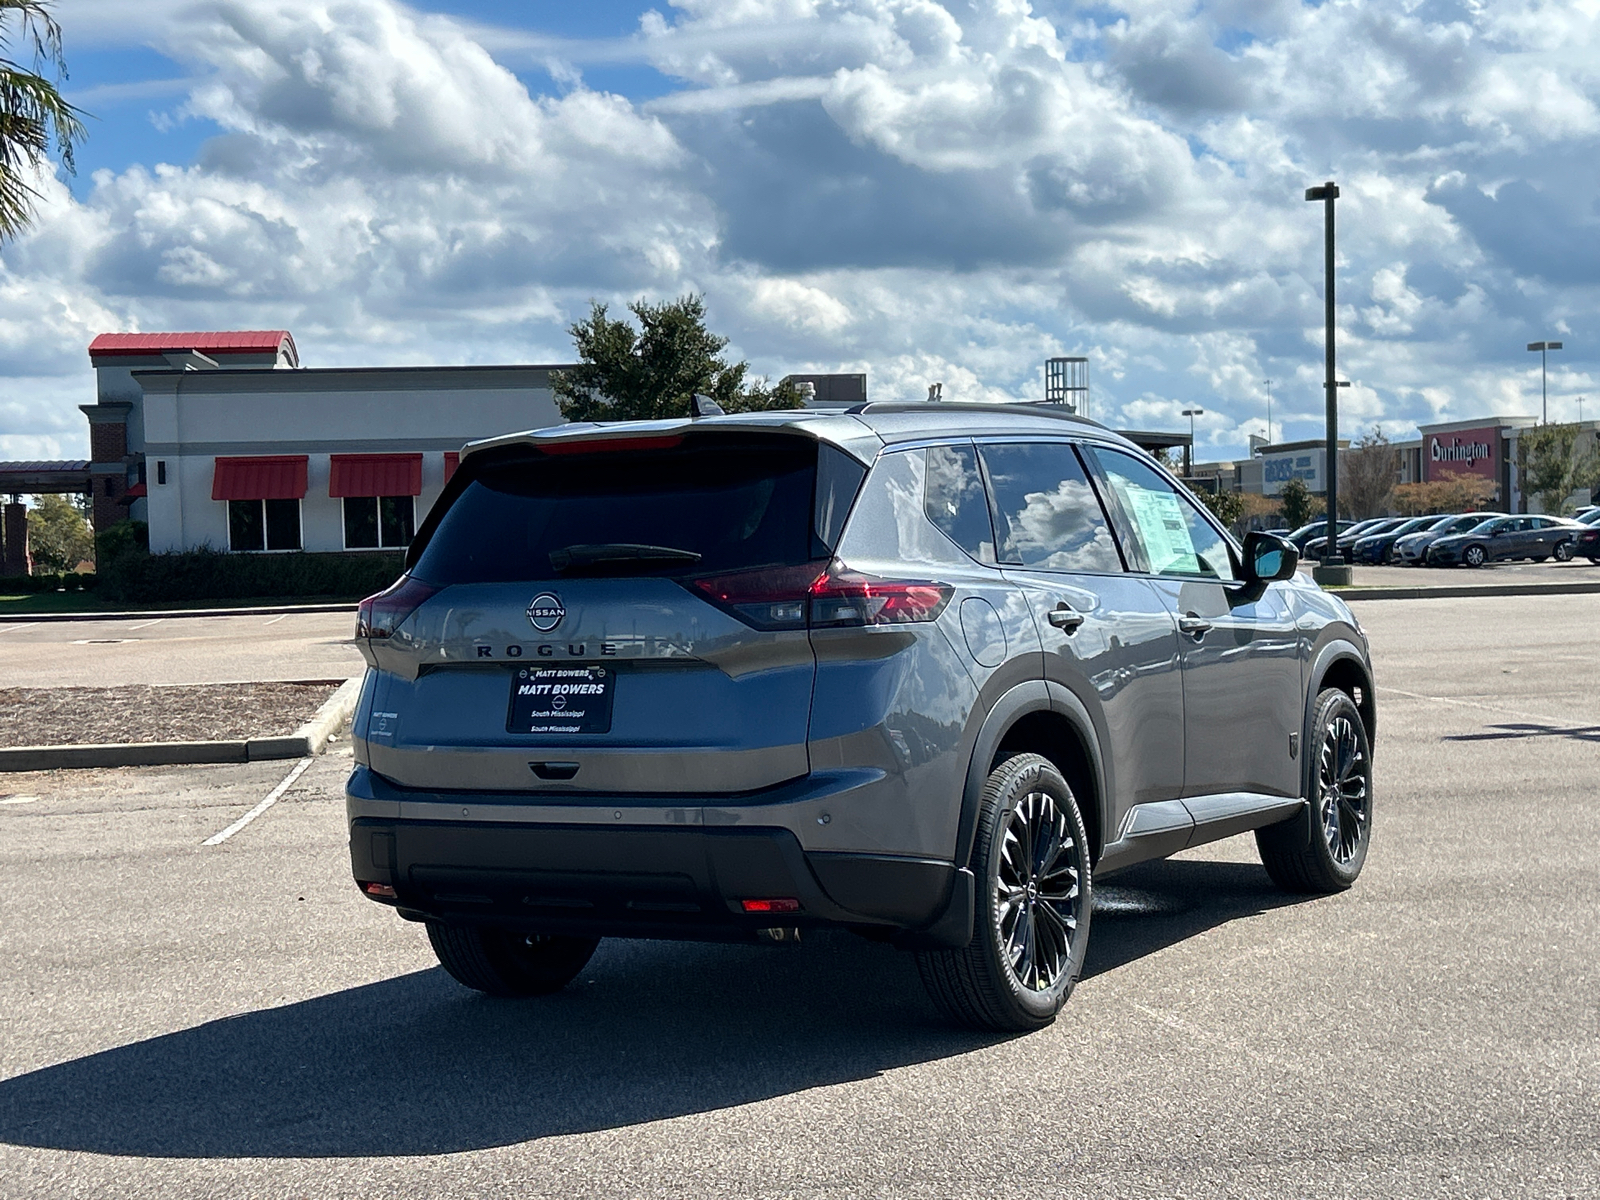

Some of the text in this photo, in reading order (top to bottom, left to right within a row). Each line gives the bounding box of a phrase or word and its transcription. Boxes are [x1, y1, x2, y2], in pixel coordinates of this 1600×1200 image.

[1431, 437, 1490, 468] Burlington
[477, 644, 616, 657] ROGUE
[535, 670, 557, 678] MATT
[556, 669, 590, 678] BOWERS
[518, 684, 605, 695] MATT BOWERS
[531, 710, 585, 719] South Mississippi
[531, 725, 581, 733] South Mississippi
